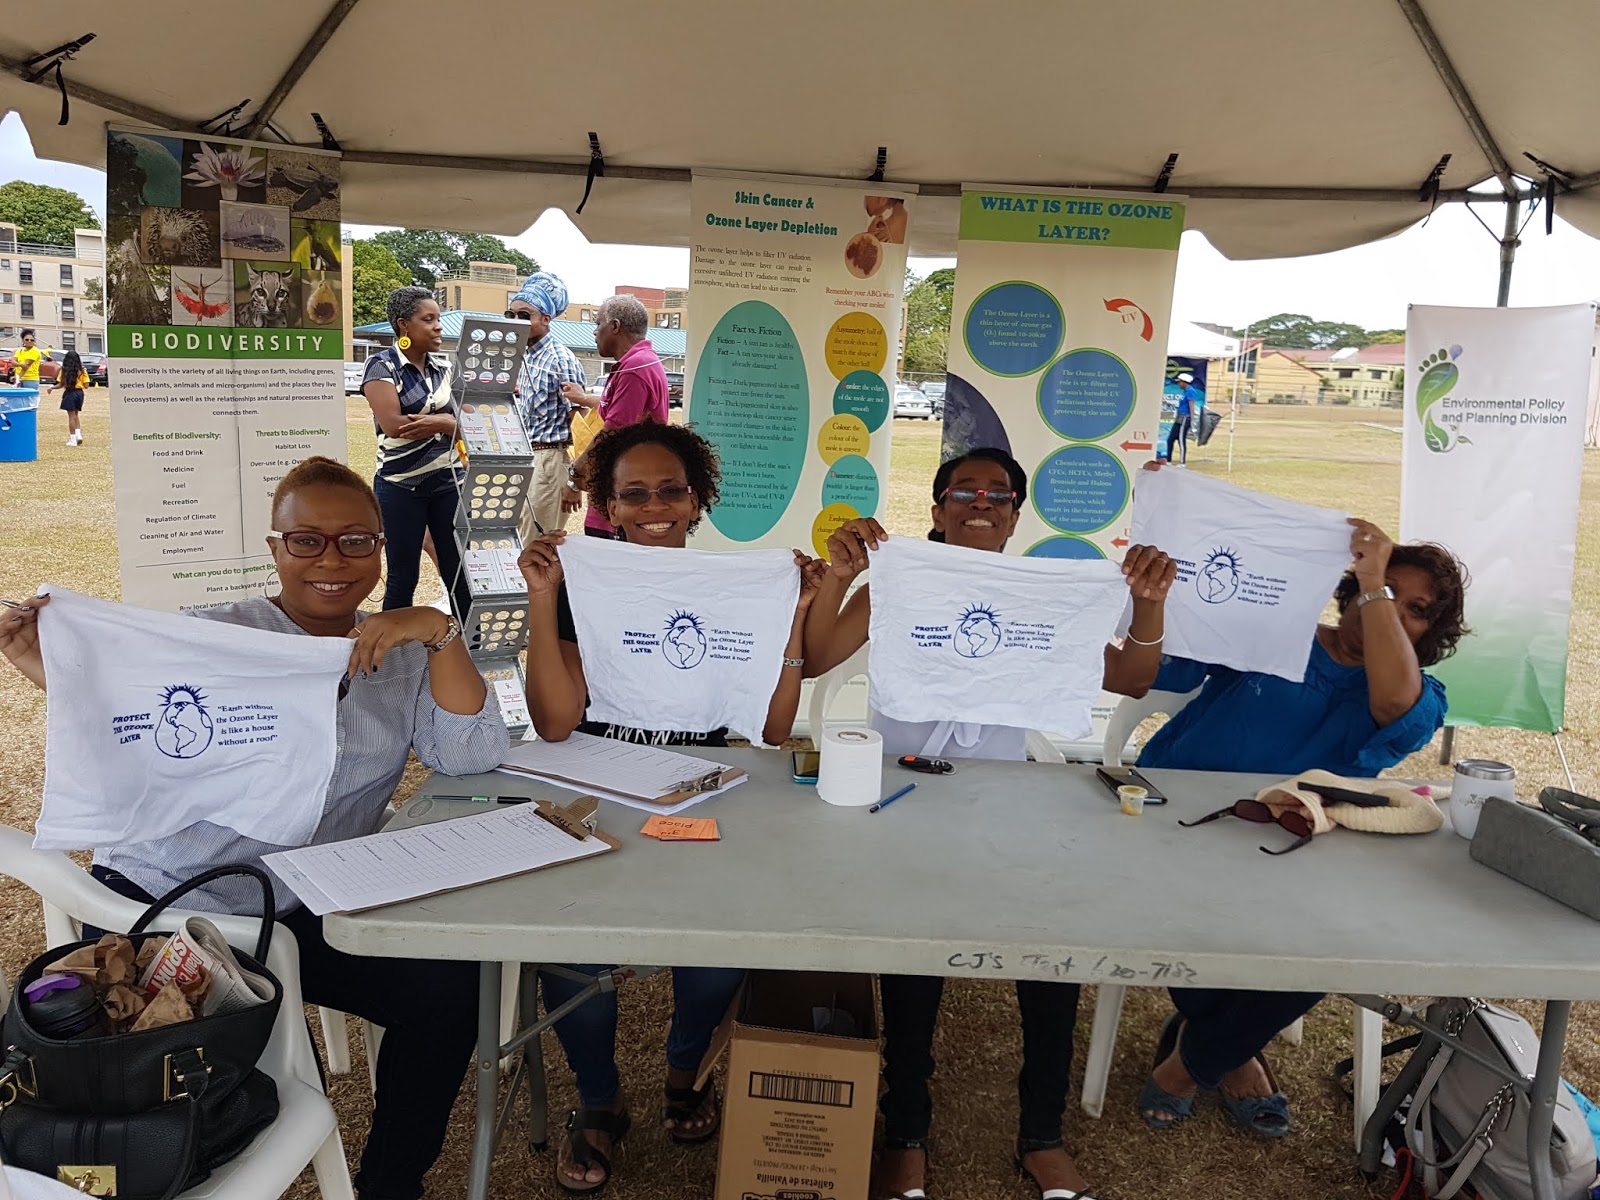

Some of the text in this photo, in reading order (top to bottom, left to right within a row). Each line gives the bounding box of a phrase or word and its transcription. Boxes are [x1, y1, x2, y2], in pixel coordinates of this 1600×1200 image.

[735, 191, 814, 209] Skin Cancer &
[981, 197, 1172, 219] WHAT IS THE OZONE
[706, 213, 837, 236] Ozone Layer Depletion
[1039, 225, 1110, 241] LAYER?
[1121, 312, 1137, 324] UV
[733, 324, 746, 333] Fact
[759, 326, 781, 336] Fiction
[131, 332, 323, 351] BIODIVERSITY
[225, 368, 242, 376] living
[147, 382, 172, 390] (plants,
[124, 395, 168, 404] (ecosystems)
[1442, 398, 1564, 412] Environmental Policy
[1441, 413, 1567, 425] and Planning Division
[175, 432, 221, 440] Biodiversity:
[289, 429, 330, 437] Biodiversity:
[1133, 431, 1149, 440] UV
[251, 459, 276, 467] Over-use
[146, 515, 181, 524] Regulation
[192, 513, 216, 521] Climate
[140, 531, 168, 540] Cleaning
[204, 528, 224, 536] Water
[163, 546, 204, 555] Employment
[173, 571, 192, 580] What
[207, 570, 221, 579] you
[243, 564, 265, 575] protect
[230, 582, 256, 592] backyard
[112, 713, 151, 723] PROTECT
[257, 714, 278, 722] Layer
[120, 733, 141, 744] LAYER
[757, 1173, 834, 1190] Galletas de Vainilla
